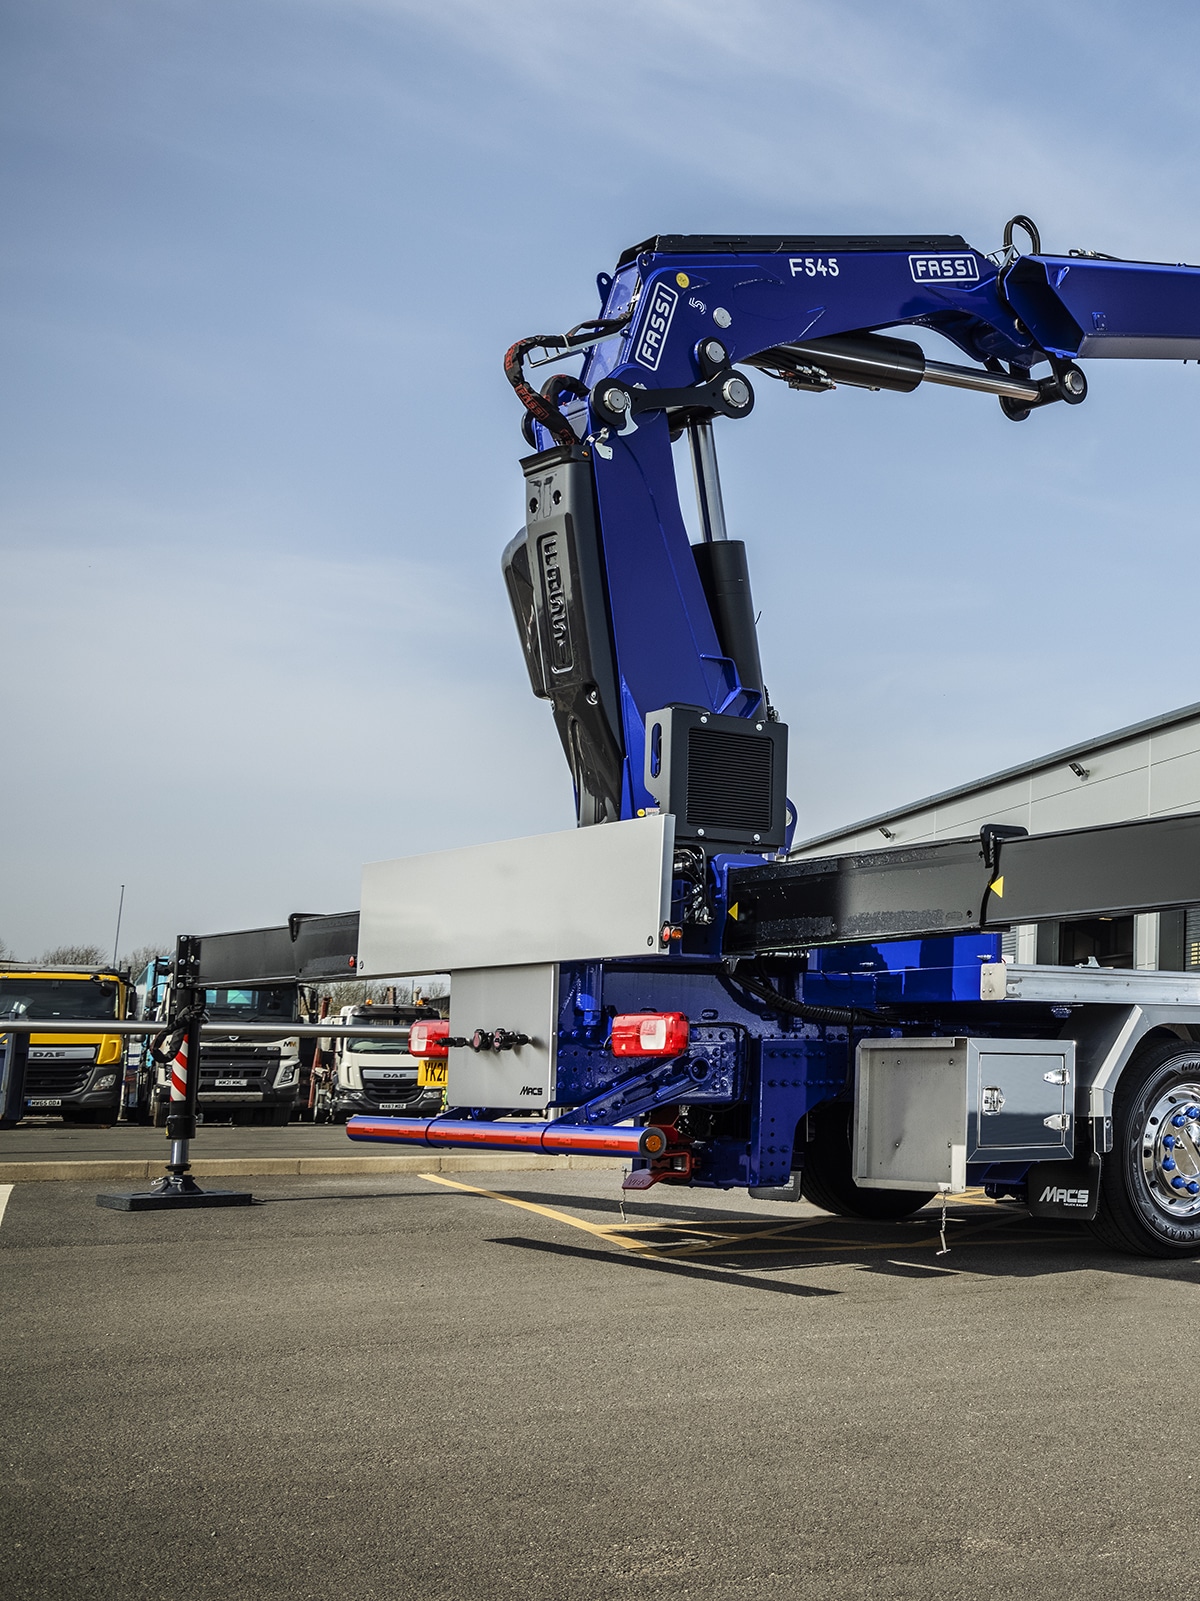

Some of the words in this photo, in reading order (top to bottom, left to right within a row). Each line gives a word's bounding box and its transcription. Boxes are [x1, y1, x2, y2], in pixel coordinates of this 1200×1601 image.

[788, 258, 840, 277] F545
[915, 260, 974, 277] FASSI
[641, 291, 673, 362] FASSI
[424, 1062, 447, 1082] YK21
[1162, 1224, 1195, 1239] KMAX
